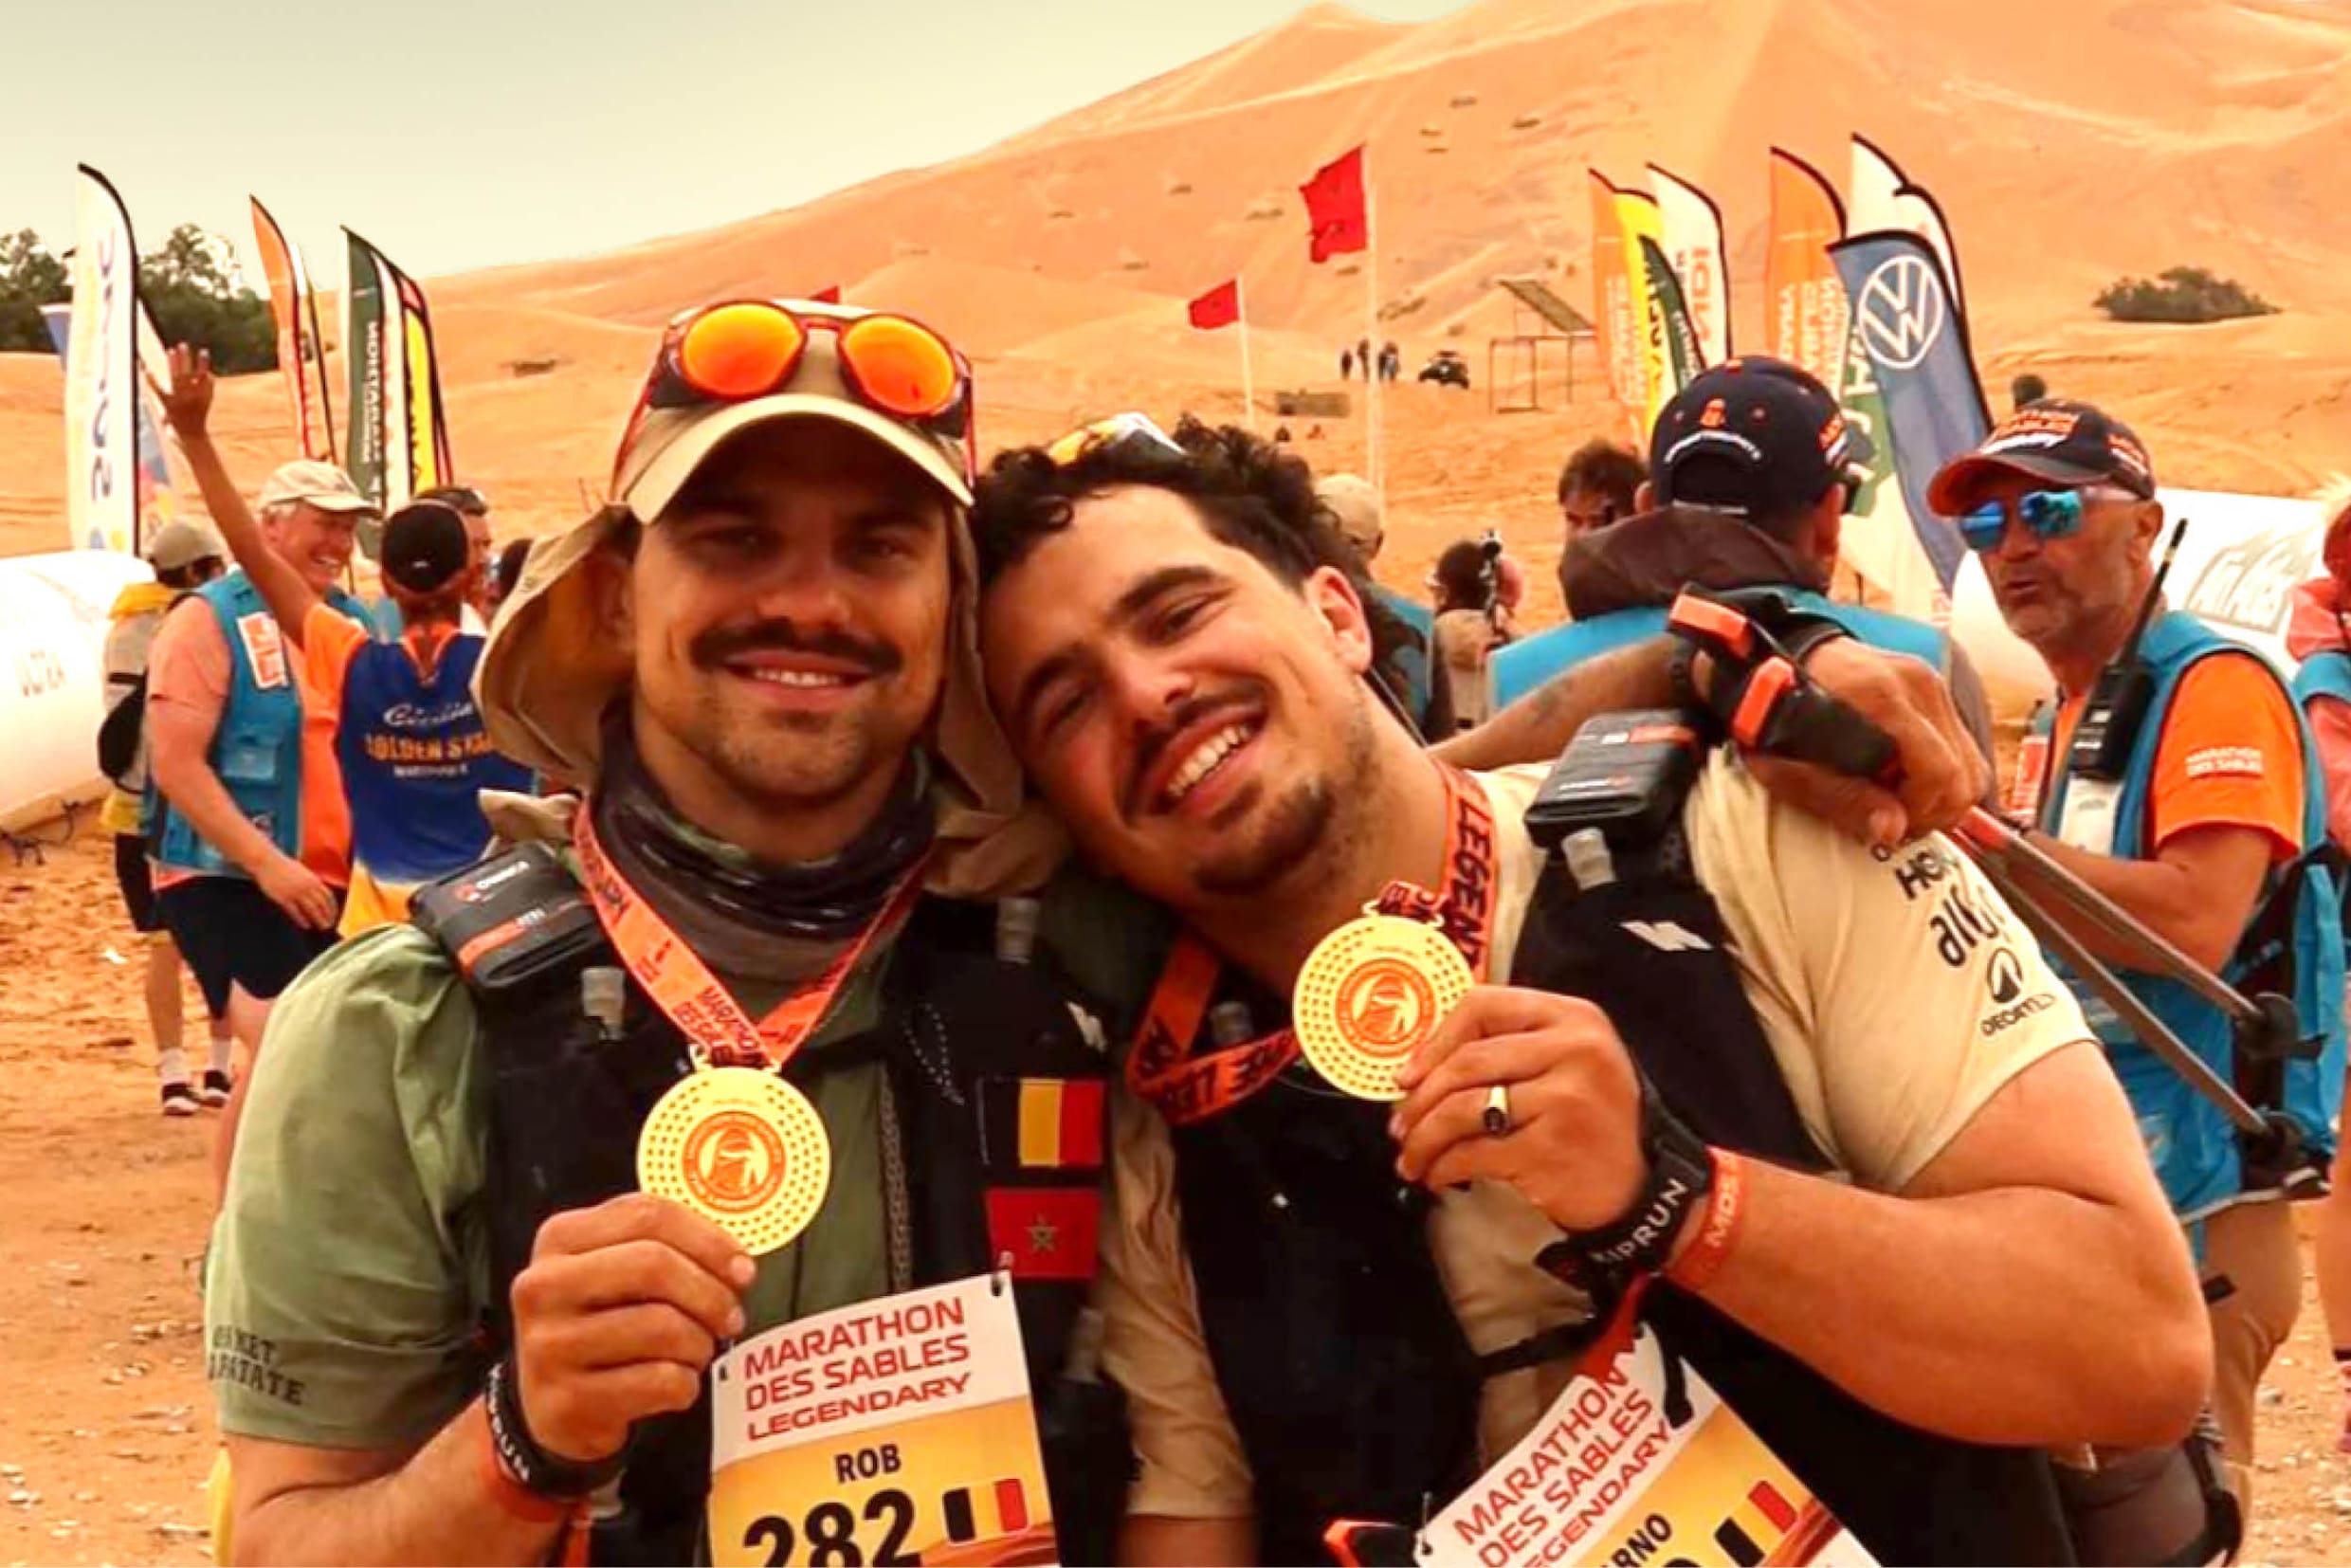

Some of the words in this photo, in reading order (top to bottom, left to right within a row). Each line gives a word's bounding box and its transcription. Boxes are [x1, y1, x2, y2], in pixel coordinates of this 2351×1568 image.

[1859, 257, 1941, 366] VW
[743, 1297, 965, 1380] MARATHON
[745, 1369, 813, 1412] DES
[823, 1334, 970, 1390] SABLES
[747, 1372, 972, 1441] LEGENDARY
[834, 1443, 902, 1485] ROB
[1452, 1368, 1629, 1547] MARATHON
[1478, 1504, 1549, 1567] DES
[1543, 1389, 1653, 1513] SABLES
[1523, 1418, 1674, 1567] EGENDARY
[742, 1488, 921, 1567] 282
[1604, 1513, 1672, 1567] RNO
